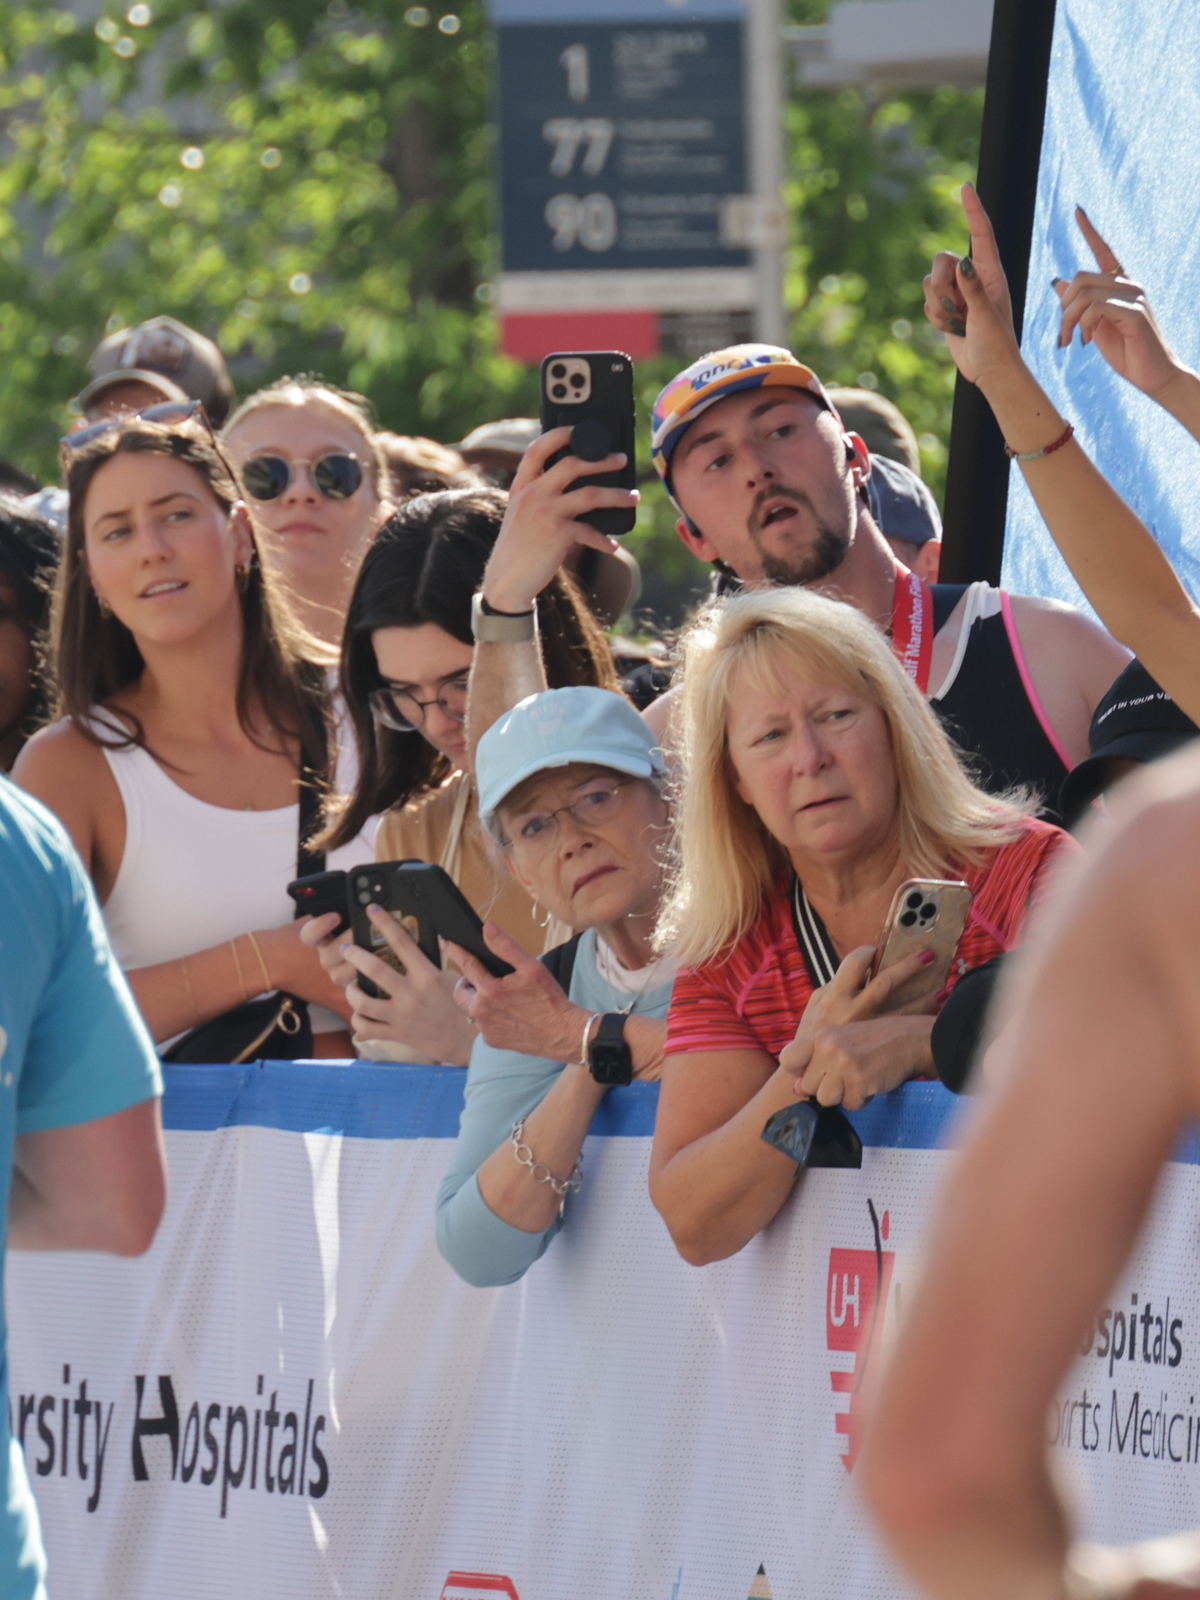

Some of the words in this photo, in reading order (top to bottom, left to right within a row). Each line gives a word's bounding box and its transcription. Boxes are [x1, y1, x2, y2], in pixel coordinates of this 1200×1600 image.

[560, 44, 590, 102] 1
[543, 117, 614, 178] 77
[545, 192, 617, 252] 90
[906, 597, 923, 657] Marathon
[831, 1272, 859, 1328] UH
[9, 1364, 114, 1513] rsity
[131, 1374, 329, 1518] Hospitals
